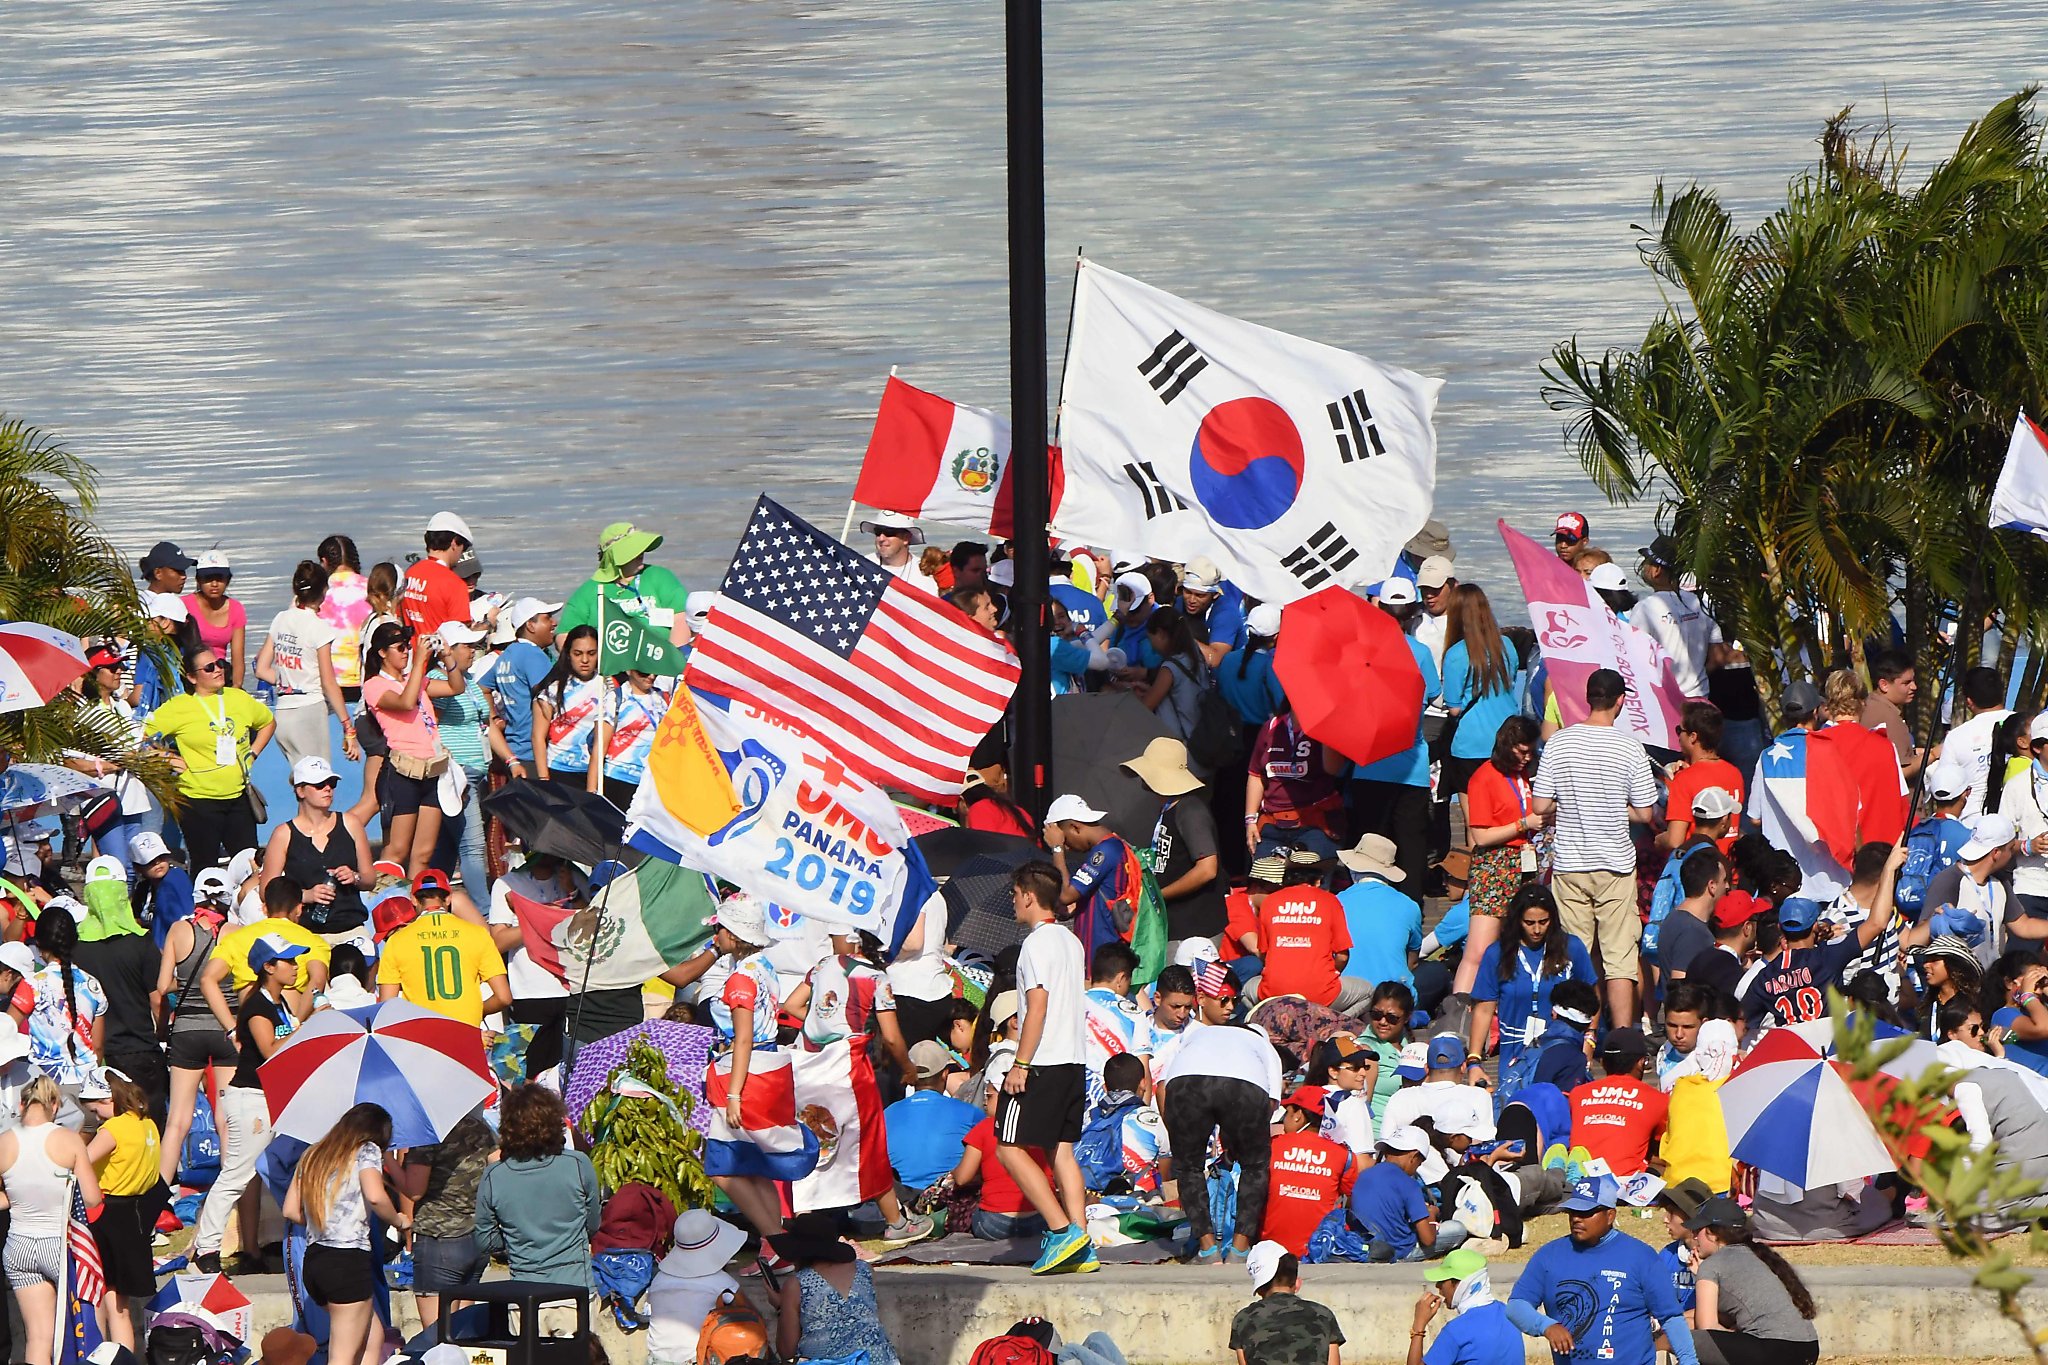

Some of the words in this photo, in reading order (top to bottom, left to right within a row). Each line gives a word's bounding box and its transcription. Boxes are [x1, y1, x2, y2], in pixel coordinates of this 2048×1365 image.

[646, 643, 664, 660] 19
[275, 652, 303, 670] AMEN
[1270, 765, 1305, 774] BIMO
[782, 810, 883, 880] PANAMÁ
[764, 837, 876, 916] 2019
[1278, 900, 1317, 915] JMJ
[417, 930, 448, 940] NEYMAR
[451, 929, 460, 939] JR
[420, 945, 463, 1001] 10
[1592, 1086, 1639, 1099] JMJ
[1283, 1147, 1327, 1165] JMJ
[1273, 1161, 1333, 1177] PANAMÁ2019
[1290, 1185, 1321, 1197] GLOBAL
